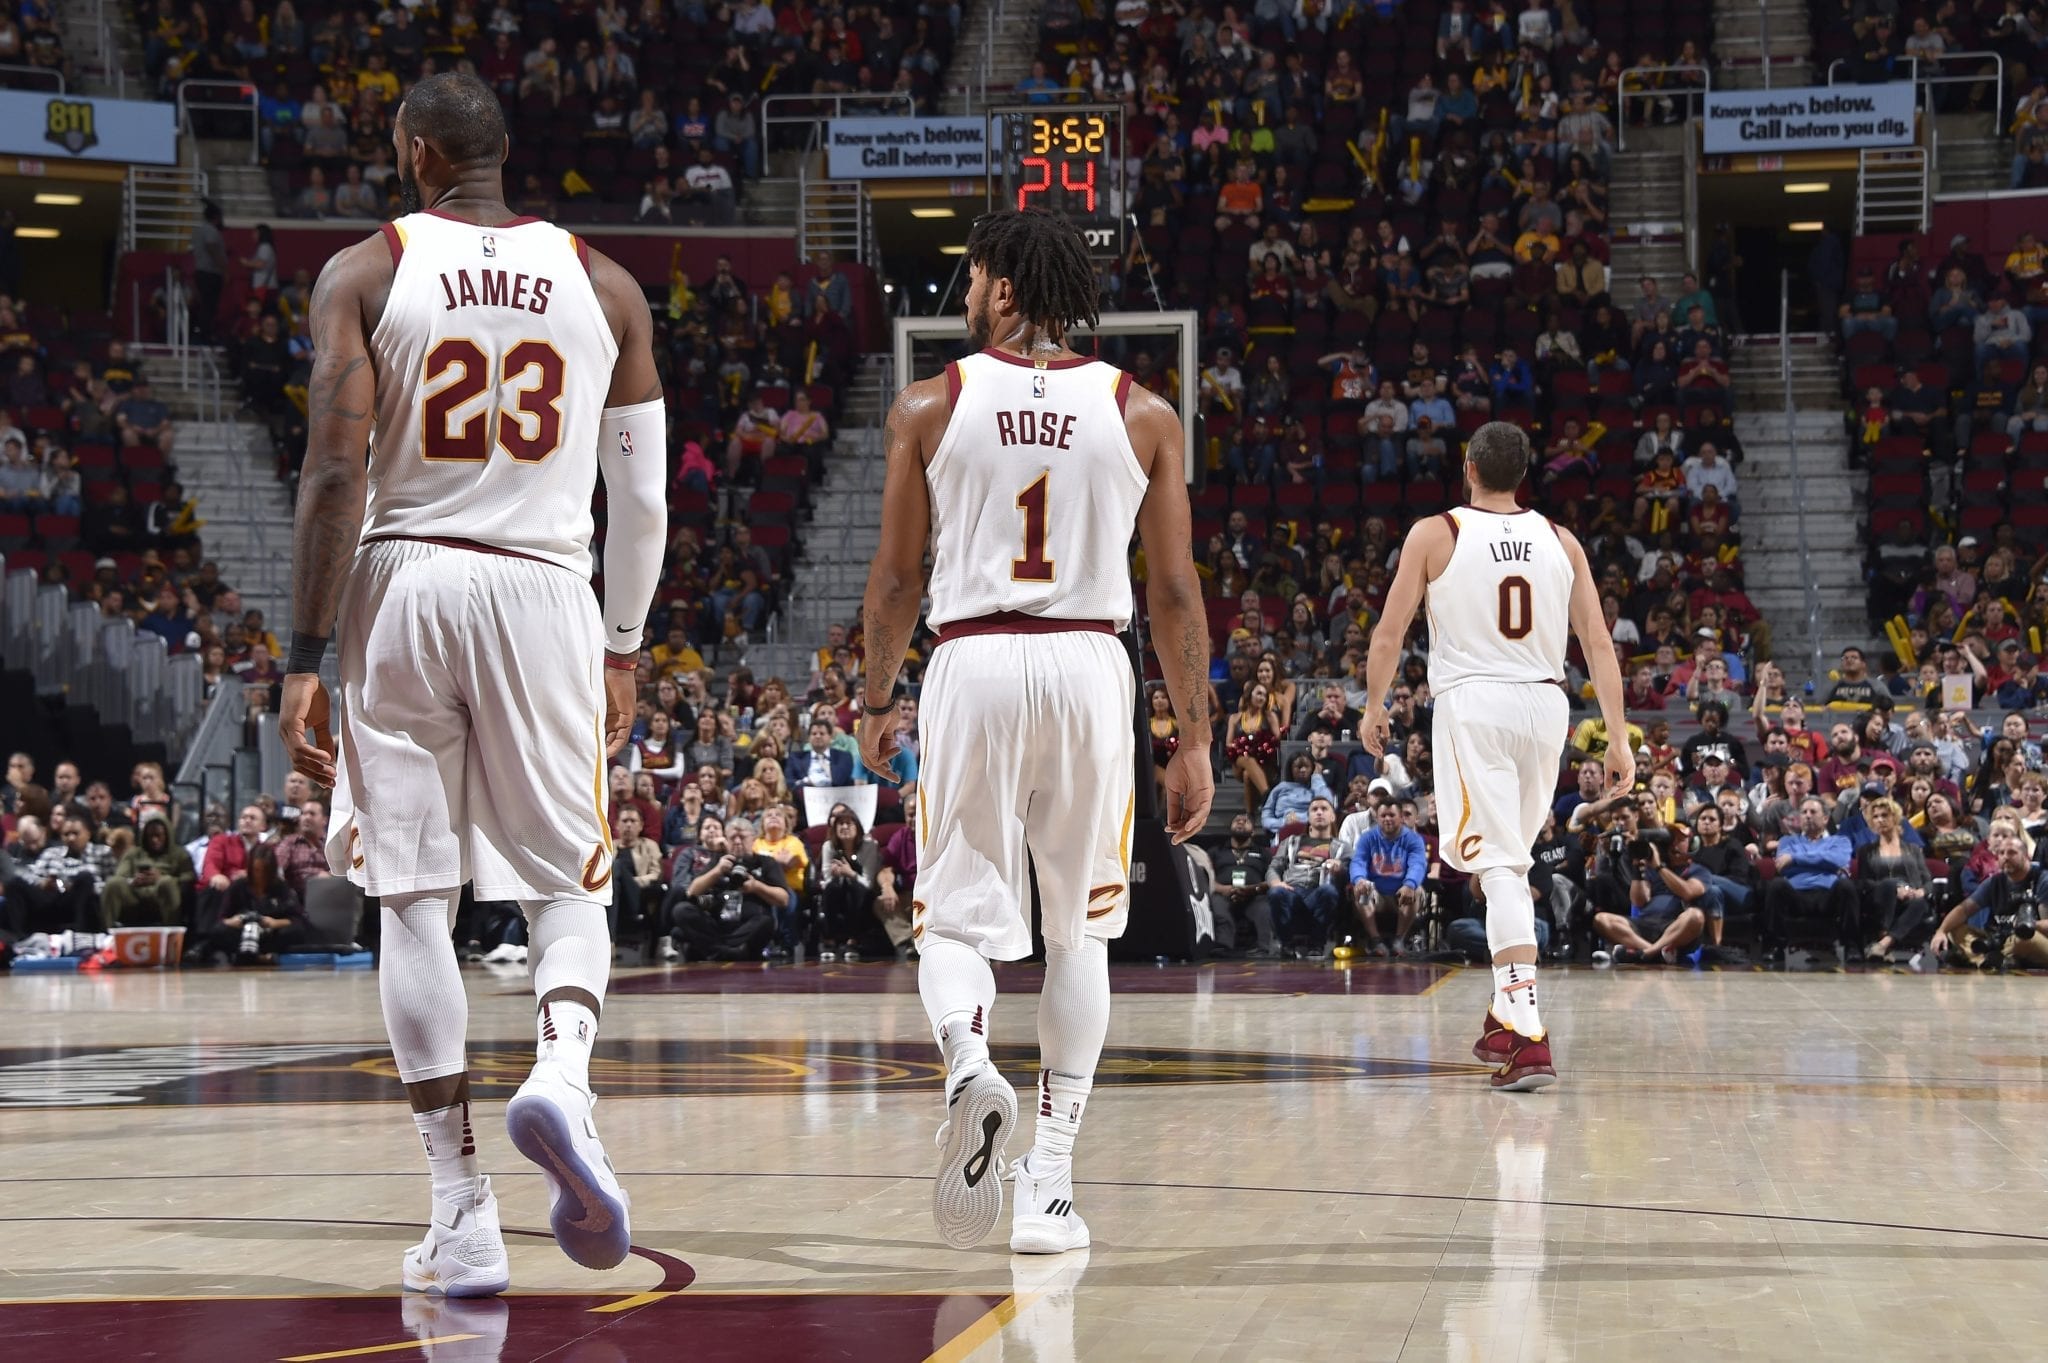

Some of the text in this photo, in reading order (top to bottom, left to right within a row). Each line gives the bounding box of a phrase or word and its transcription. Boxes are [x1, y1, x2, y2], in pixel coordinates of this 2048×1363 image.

[49, 101, 94, 134] 811
[1710, 96, 1876, 119] Know what's below.
[834, 126, 983, 147] Know what's below.
[1032, 117, 1105, 154] 3:52
[1740, 118, 1909, 140] Call before you dig.
[862, 148, 899, 168] Call
[903, 151, 952, 167] before
[953, 152, 983, 170] you
[1017, 157, 1096, 213] 24
[440, 269, 553, 315] JAMES
[421, 337, 567, 465] 23
[996, 410, 1077, 450] ROSE
[1010, 469, 1056, 583] 1
[1489, 541, 1532, 563] LOVE
[1498, 575, 1533, 640] 0
[126, 934, 151, 962] G
